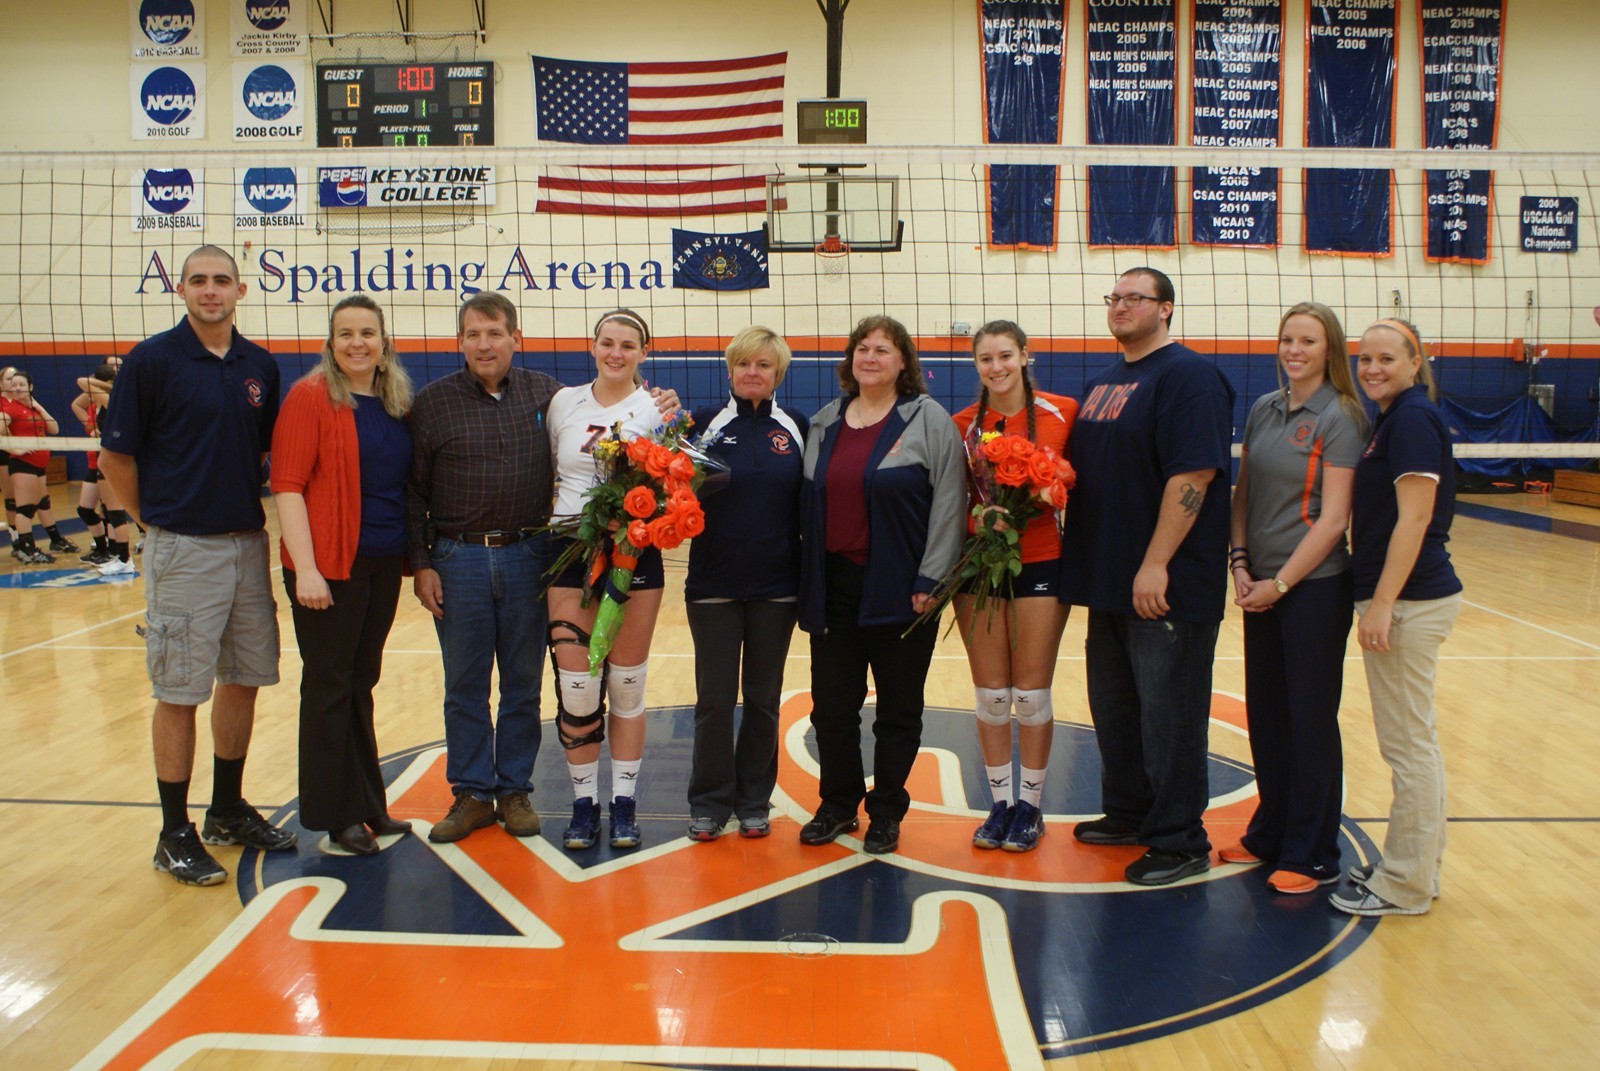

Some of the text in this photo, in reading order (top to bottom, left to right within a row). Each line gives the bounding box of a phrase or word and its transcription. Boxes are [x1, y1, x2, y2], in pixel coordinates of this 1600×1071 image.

[1345, 0, 1394, 9] CHAMPS
[250, 6, 289, 20] NCAA
[1222, 7, 1252, 18] 2004
[1338, 10, 1367, 20] 2005
[1423, 8, 1453, 18] NEAC
[146, 15, 192, 30] NCAA
[984, 18, 1015, 29] NEAC
[1089, 22, 1174, 32] NEAC CHAMPS
[1196, 21, 1279, 34] NEAC CHAMPS
[1311, 25, 1393, 38] NEAC CHAMPS
[1117, 34, 1146, 44] 2005
[1222, 34, 1251, 44] 2005
[1336, 39, 1366, 49] 2006
[1424, 35, 1454, 47] ECAC
[986, 43, 1018, 54] CSAC
[1090, 50, 1174, 61] NEAC MEN'S CHAMPS
[1195, 50, 1279, 63] ECAC CHAMPS
[448, 67, 484, 78] HOME
[1117, 62, 1147, 72] 2006
[1222, 63, 1251, 73] 2005
[324, 70, 364, 80] GUEST
[398, 67, 434, 91] 1:00
[1090, 79, 1173, 90] NEAC MEN'S CHAMPS
[1194, 78, 1278, 90] NEAC CHAMPS
[346, 84, 360, 108] 0
[468, 81, 482, 105] 0
[1116, 90, 1146, 101] 2007
[1221, 90, 1250, 101] 2006
[146, 95, 194, 111] NCAA
[249, 91, 294, 107] NCAA
[374, 104, 409, 114] PERIOD
[422, 99, 426, 117] 1
[1195, 107, 1278, 119] NEAC CHAMPS
[826, 108, 859, 128] 1:00
[1221, 119, 1251, 130] 2007
[147, 127, 190, 136] 2010 GOLF
[236, 126, 302, 137] 2008 GOLF
[1193, 136, 1276, 148] NEAC CHAMPS
[320, 168, 366, 182] PEPSI
[370, 168, 491, 183] KEYSTONE
[1208, 167, 1261, 175] NCAA'S
[1220, 176, 1249, 186] 2008
[149, 185, 193, 201] NCAA
[249, 184, 296, 200] NCAA
[381, 186, 481, 202] COLLEGE
[1193, 190, 1276, 201] CSAC CHAMPS
[1220, 203, 1250, 213] 2010
[1538, 199, 1559, 208] 2004
[137, 216, 200, 229] 2009 BASEBALL
[236, 215, 305, 227] 2008 BASEBALL
[1213, 217, 1254, 227] NCAA'S
[1523, 210, 1574, 224] USCAA Golf
[1220, 230, 1250, 239] 2010
[1531, 225, 1566, 236] National
[674, 236, 767, 272] PENNSYLVANIA
[258, 248, 486, 303] Spalding
[496, 246, 666, 291] Arena
[580, 424, 607, 454] 7
